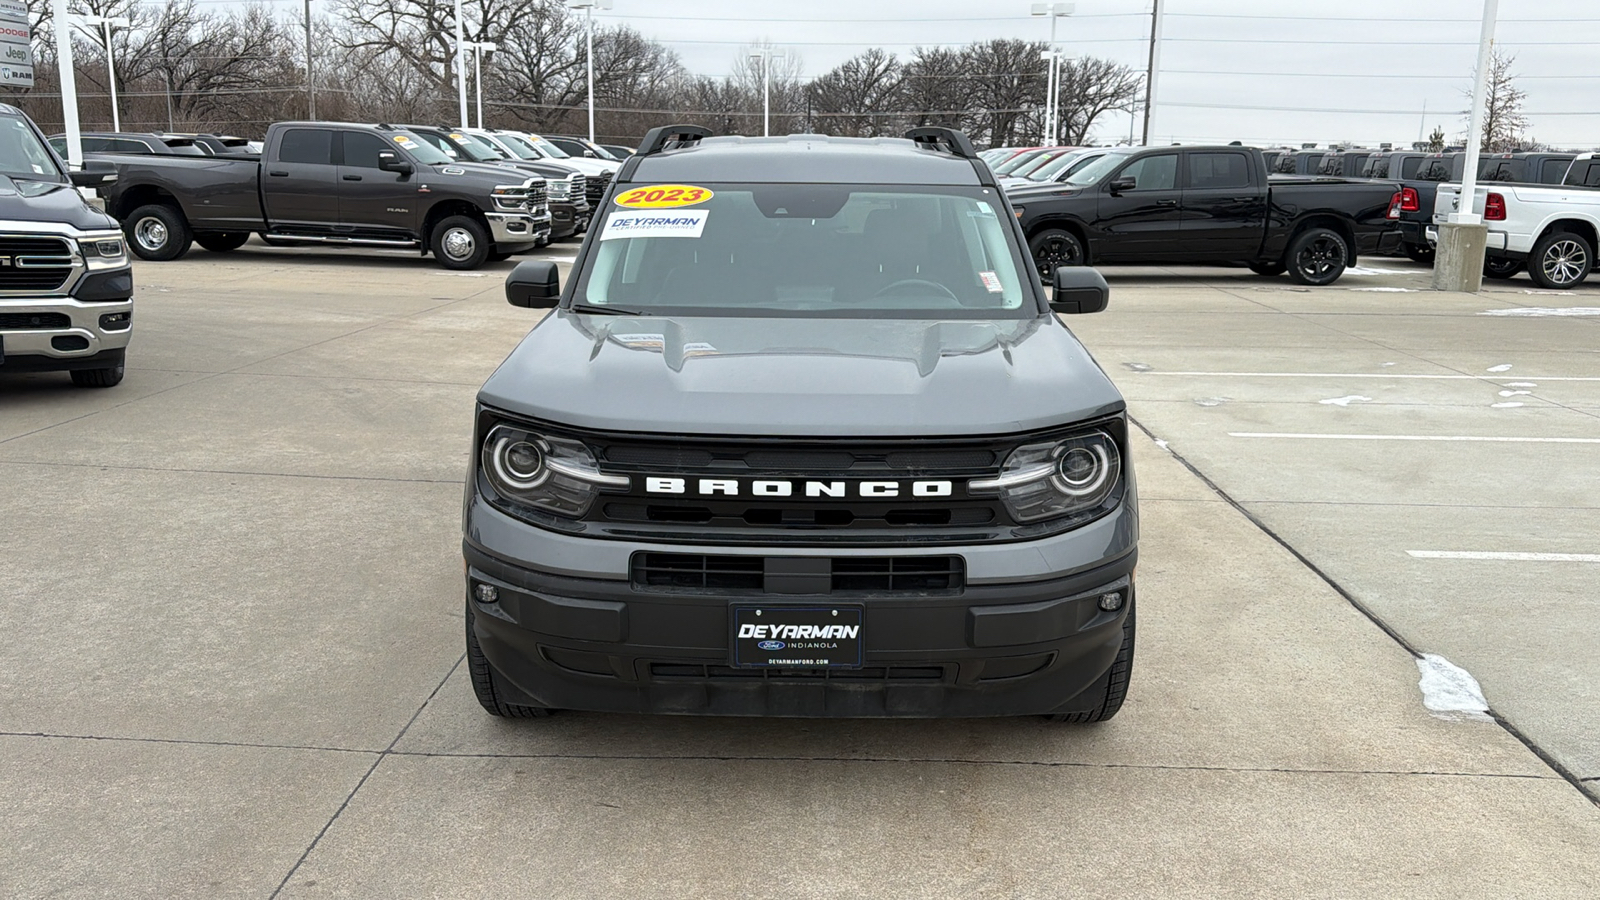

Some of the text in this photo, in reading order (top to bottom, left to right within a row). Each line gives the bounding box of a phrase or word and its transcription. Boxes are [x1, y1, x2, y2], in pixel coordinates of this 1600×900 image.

[0, 3, 26, 12] HRYSLER
[0, 27, 28, 38] DODGE
[6, 46, 26, 61] Jeep
[12, 71, 32, 79] RAM
[623, 189, 704, 204] 2023
[611, 217, 701, 228] DEYARMAN
[646, 476, 953, 497] BRONCO
[738, 624, 860, 639] DEYARMAN
